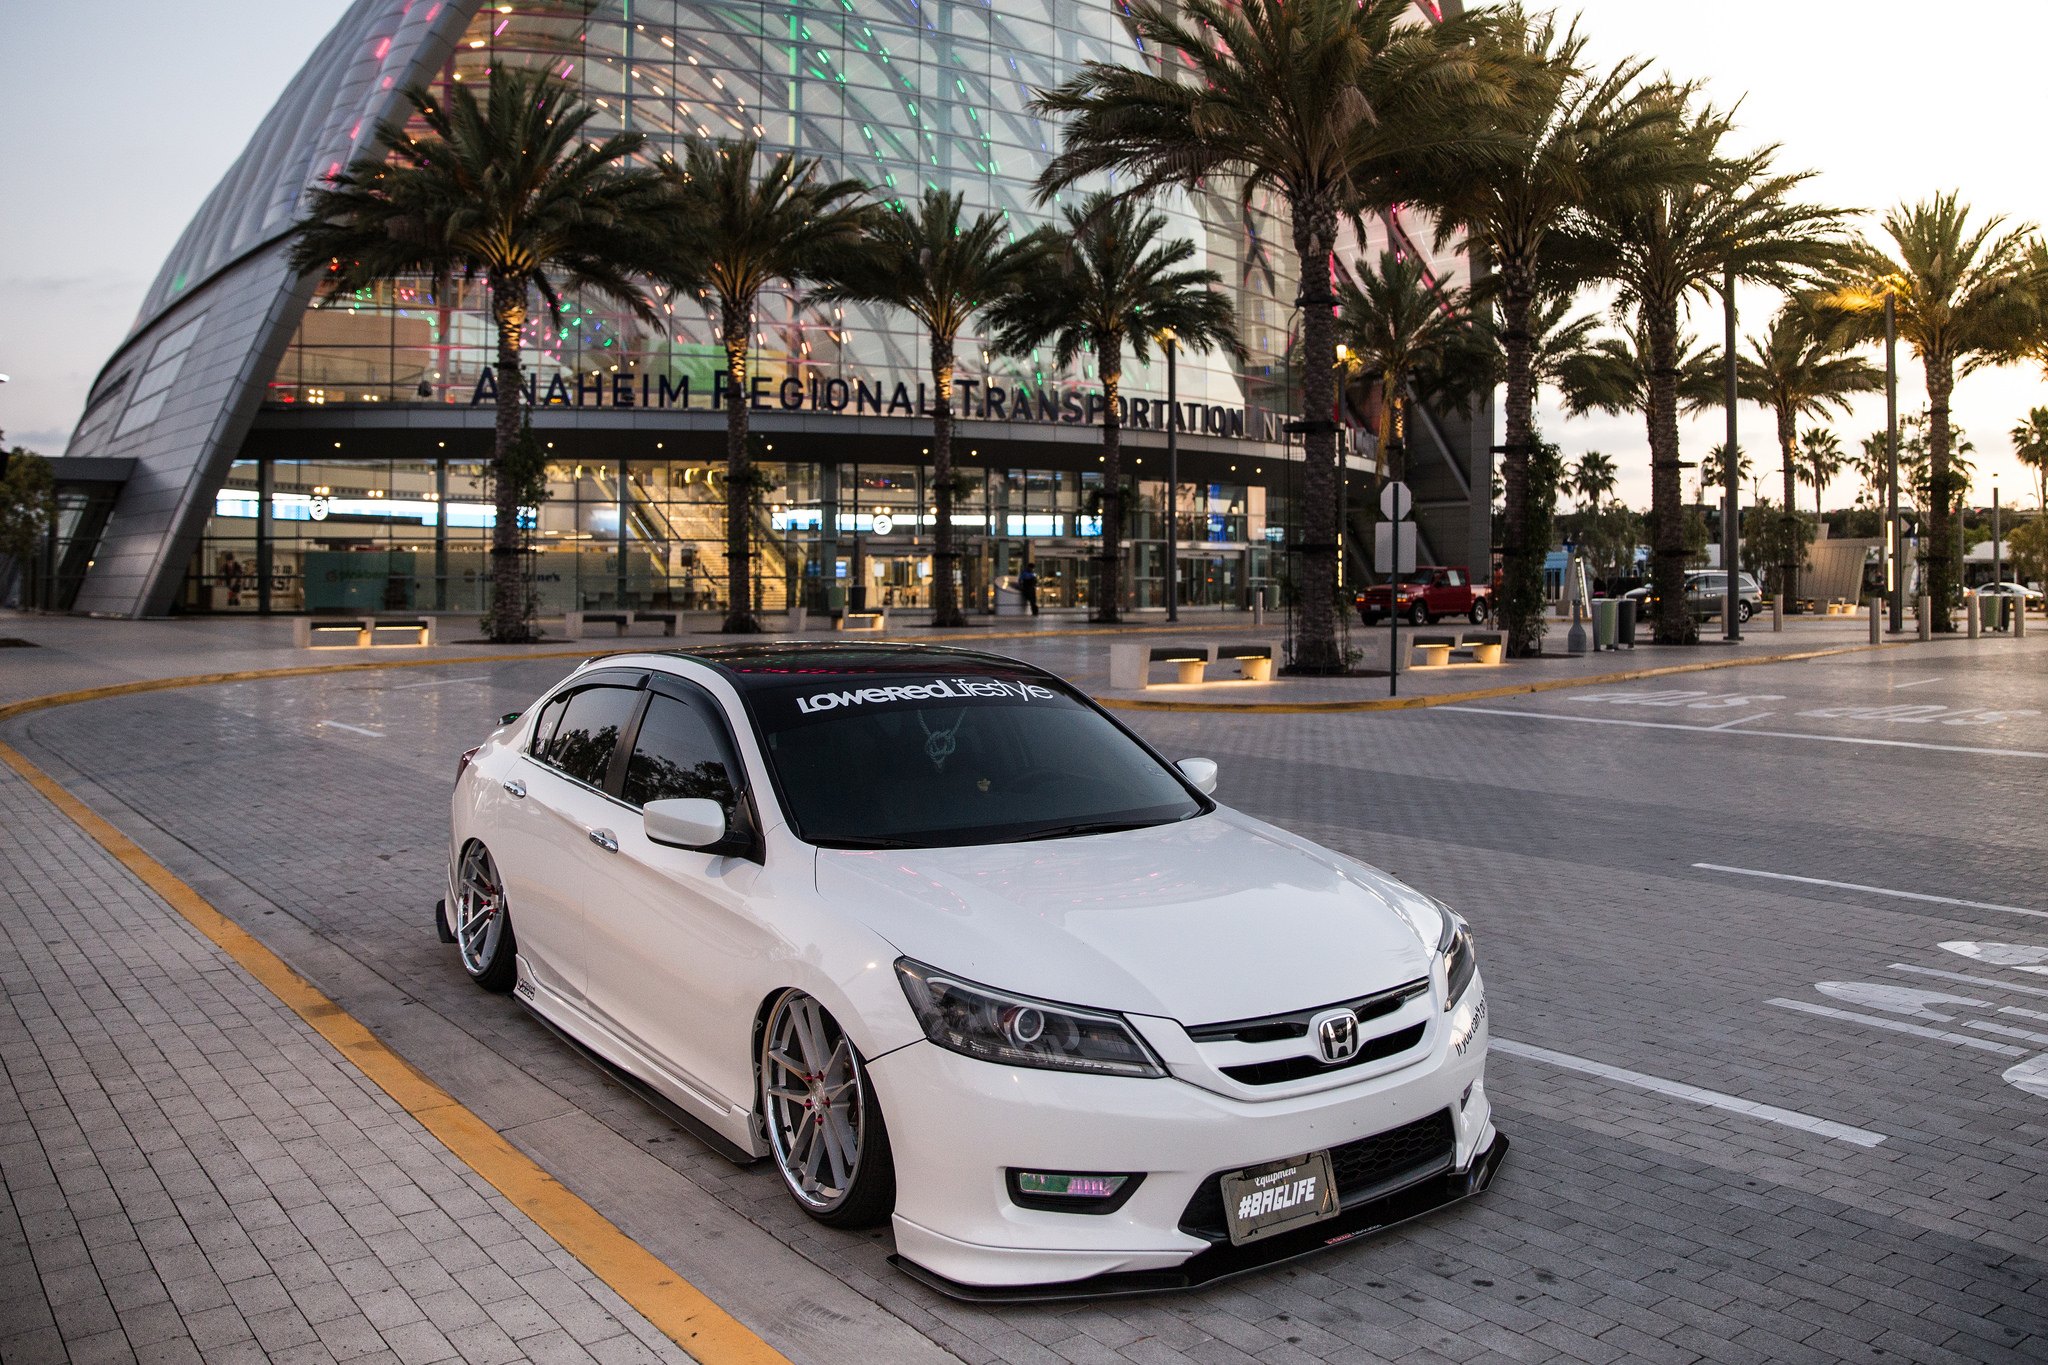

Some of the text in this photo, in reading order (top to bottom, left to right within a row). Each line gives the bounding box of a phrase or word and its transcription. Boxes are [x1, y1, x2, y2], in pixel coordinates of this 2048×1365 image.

[470, 366, 689, 408] ANAHEIM
[713, 370, 946, 417] REGIONAL
[1238, 1176, 1317, 1220] #BAGLIFE
